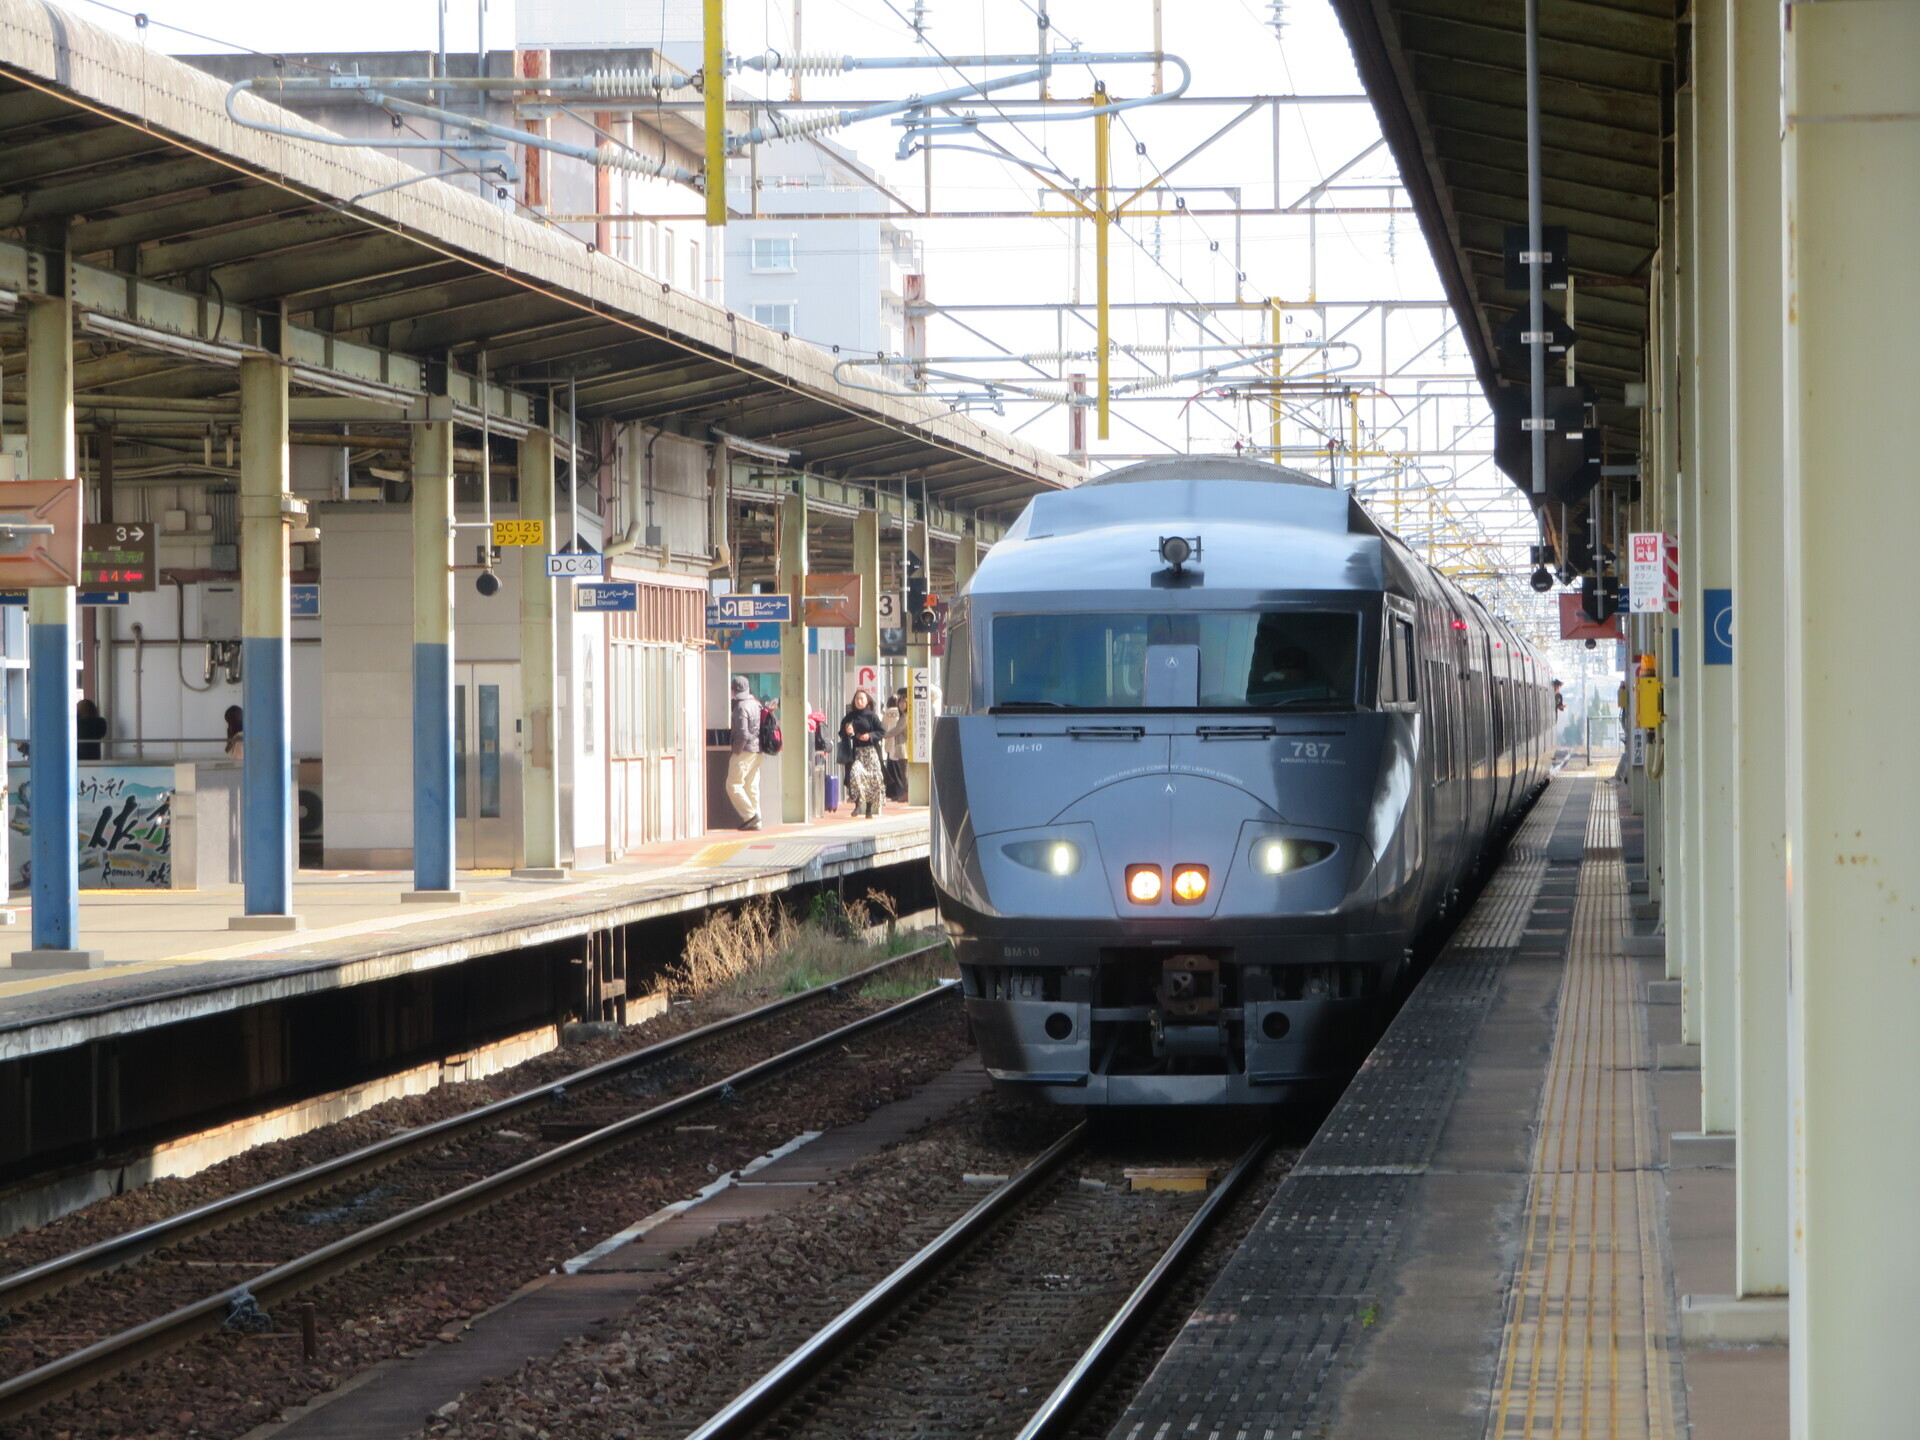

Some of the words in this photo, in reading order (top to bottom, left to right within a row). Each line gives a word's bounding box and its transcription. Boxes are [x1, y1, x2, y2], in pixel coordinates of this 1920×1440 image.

[496, 522, 541, 533] DC125
[116, 526, 127, 542] 3
[496, 534, 541, 545] ワンマン
[1635, 536, 1656, 545] STOP
[583, 559, 593, 571] 4
[597, 589, 635, 600] エレベーター
[754, 601, 787, 610] エレベーター
[879, 595, 893, 616] 3
[1007, 743, 1043, 754] BM-10
[1290, 742, 1331, 758] 787
